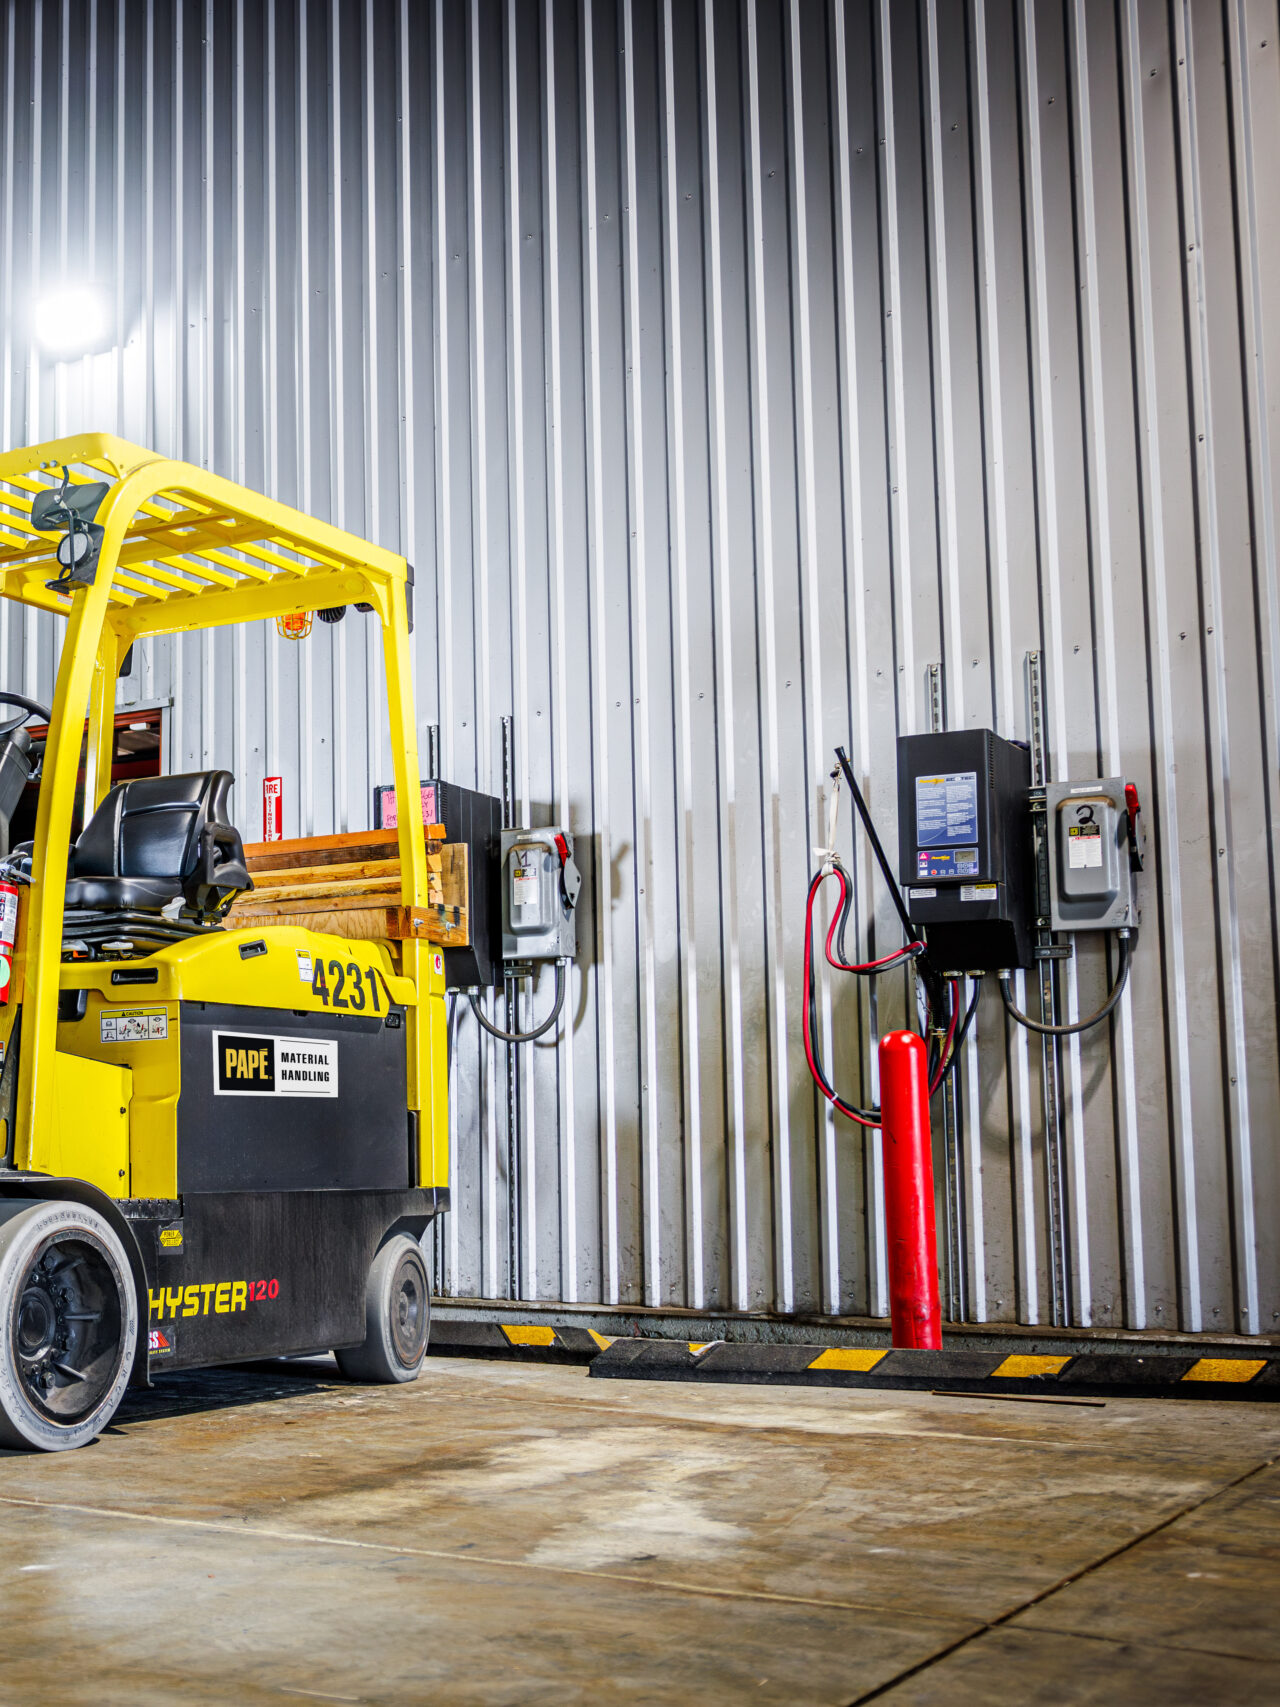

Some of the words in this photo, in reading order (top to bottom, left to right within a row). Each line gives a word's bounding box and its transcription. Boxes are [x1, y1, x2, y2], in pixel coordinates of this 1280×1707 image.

[312, 958, 381, 1012] 4231
[225, 1048, 269, 1080] PAPÉ
[281, 1052, 330, 1066] MATERIAL
[281, 1069, 330, 1082] HANDLING
[149, 1280, 247, 1320] HYSTER
[248, 1278, 280, 1302] 120
